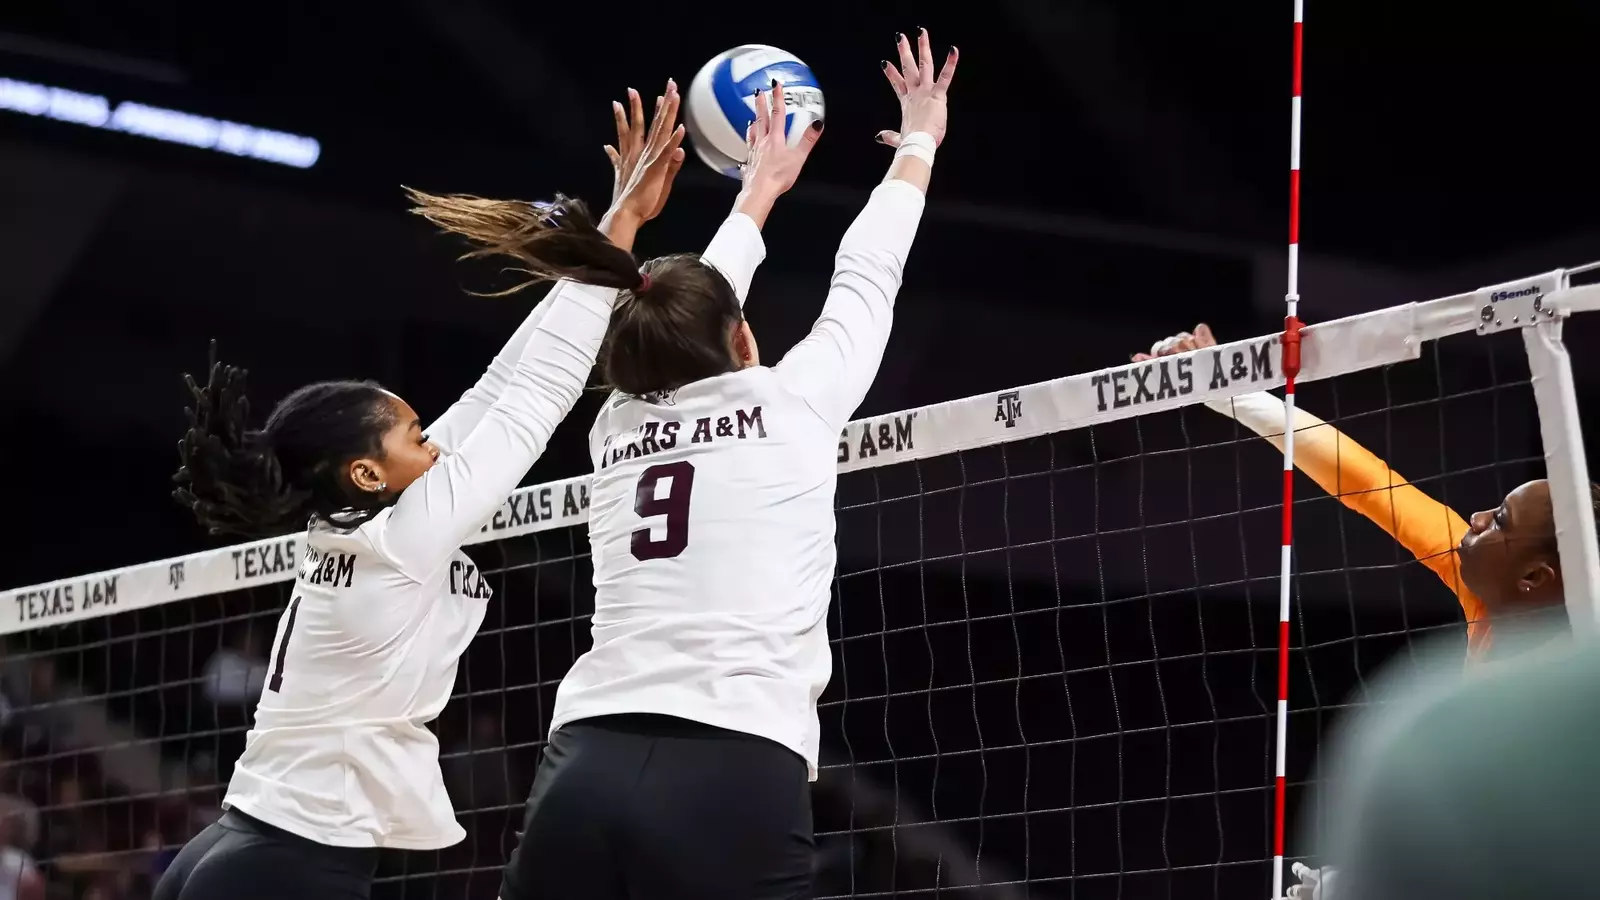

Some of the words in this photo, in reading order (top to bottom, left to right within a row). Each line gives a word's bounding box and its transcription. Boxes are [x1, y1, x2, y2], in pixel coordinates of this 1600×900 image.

[1498, 285, 1541, 301] Senoh
[1091, 357, 1194, 412] TEXAS
[1208, 341, 1273, 390] A&M
[691, 405, 768, 444] A&M
[858, 412, 915, 460] A&M
[481, 487, 553, 533] EXAS
[562, 483, 592, 518] A&
[630, 460, 695, 562] 9
[231, 540, 297, 580] TEXAS
[310, 552, 357, 588] A&M
[15, 585, 75, 623] TEXAS
[82, 575, 119, 611] A&M
[269, 595, 303, 694] 1
